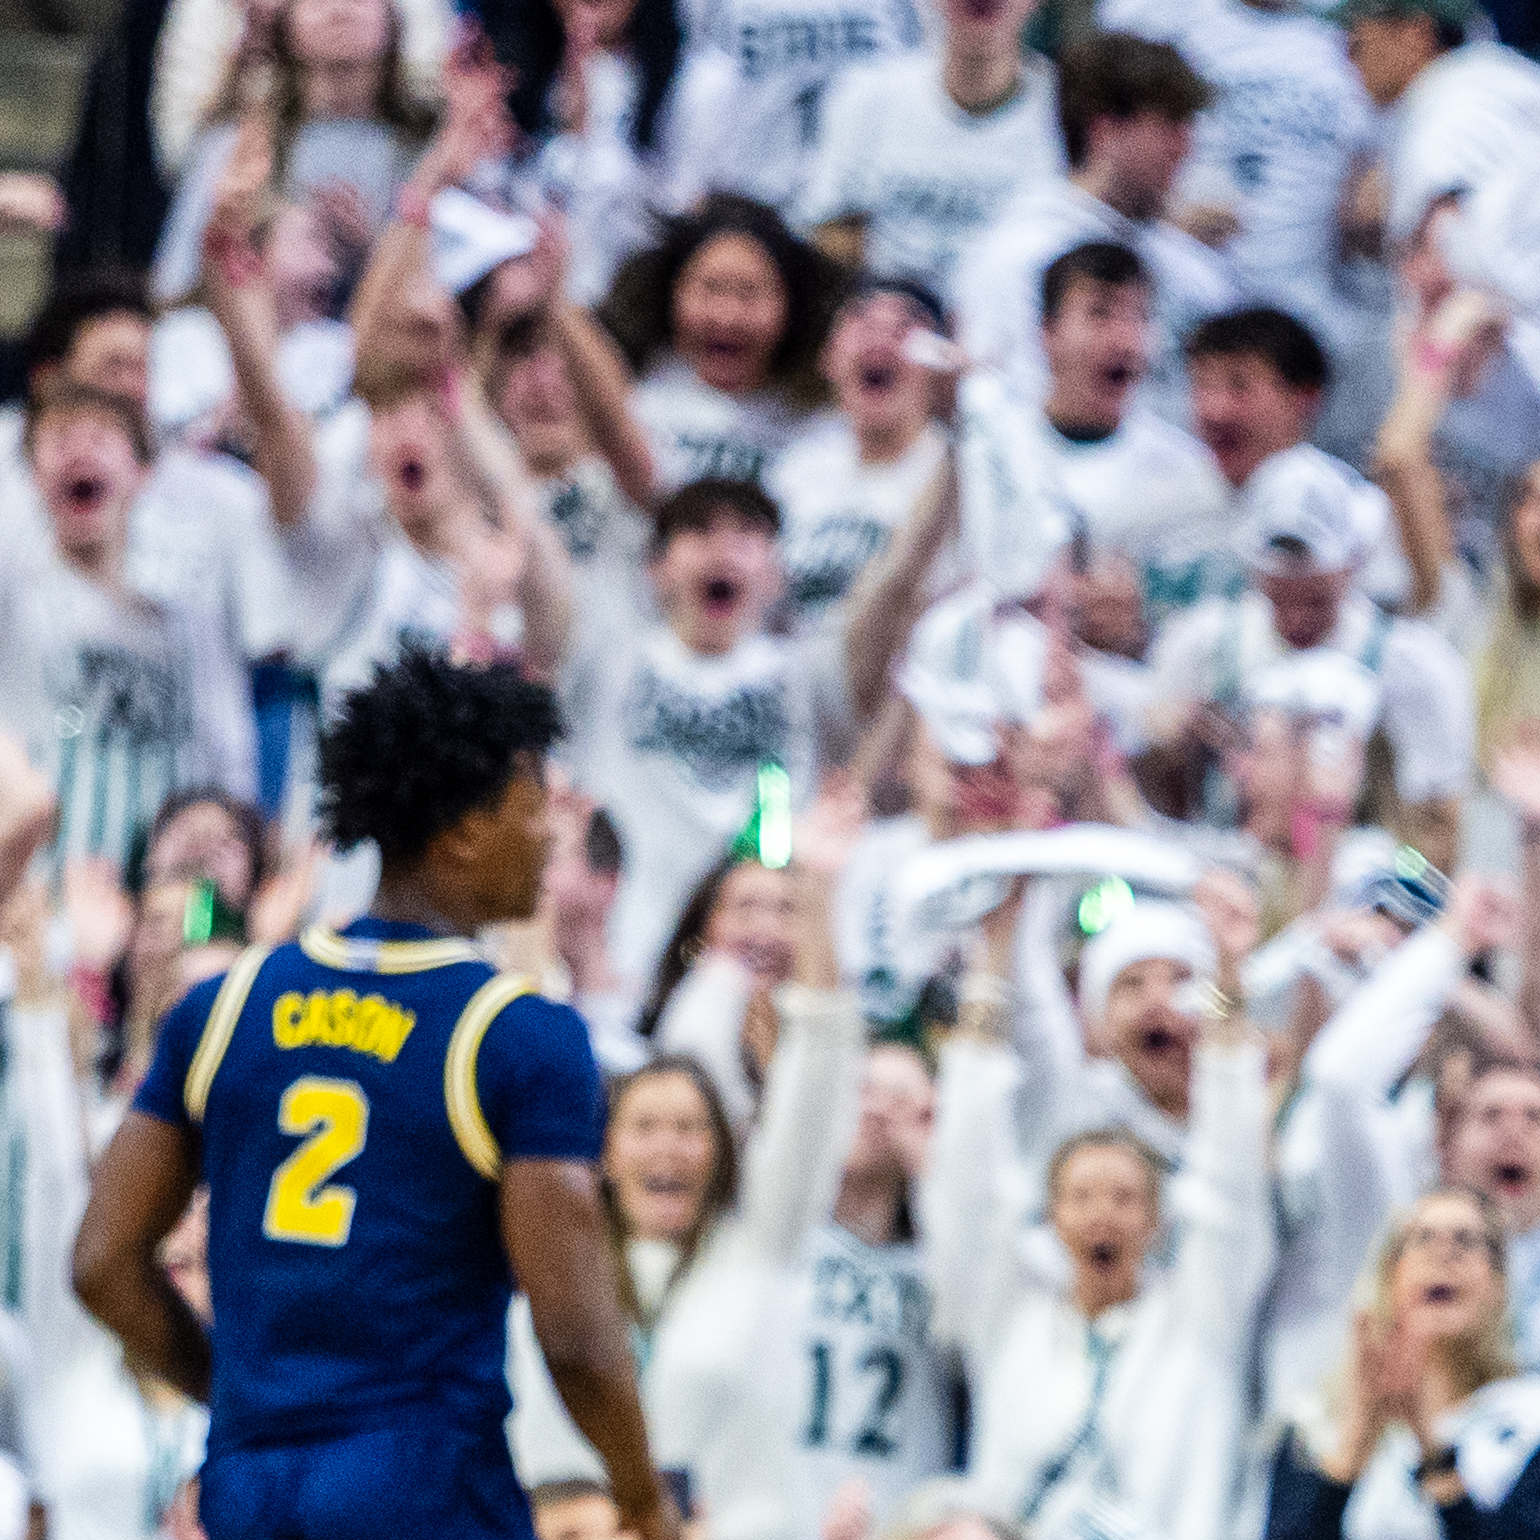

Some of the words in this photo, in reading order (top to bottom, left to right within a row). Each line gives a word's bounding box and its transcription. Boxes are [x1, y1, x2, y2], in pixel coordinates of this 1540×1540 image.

[272, 987, 418, 1063] CASON
[261, 1072, 372, 1249] 2
[806, 1344, 903, 1456] 12
